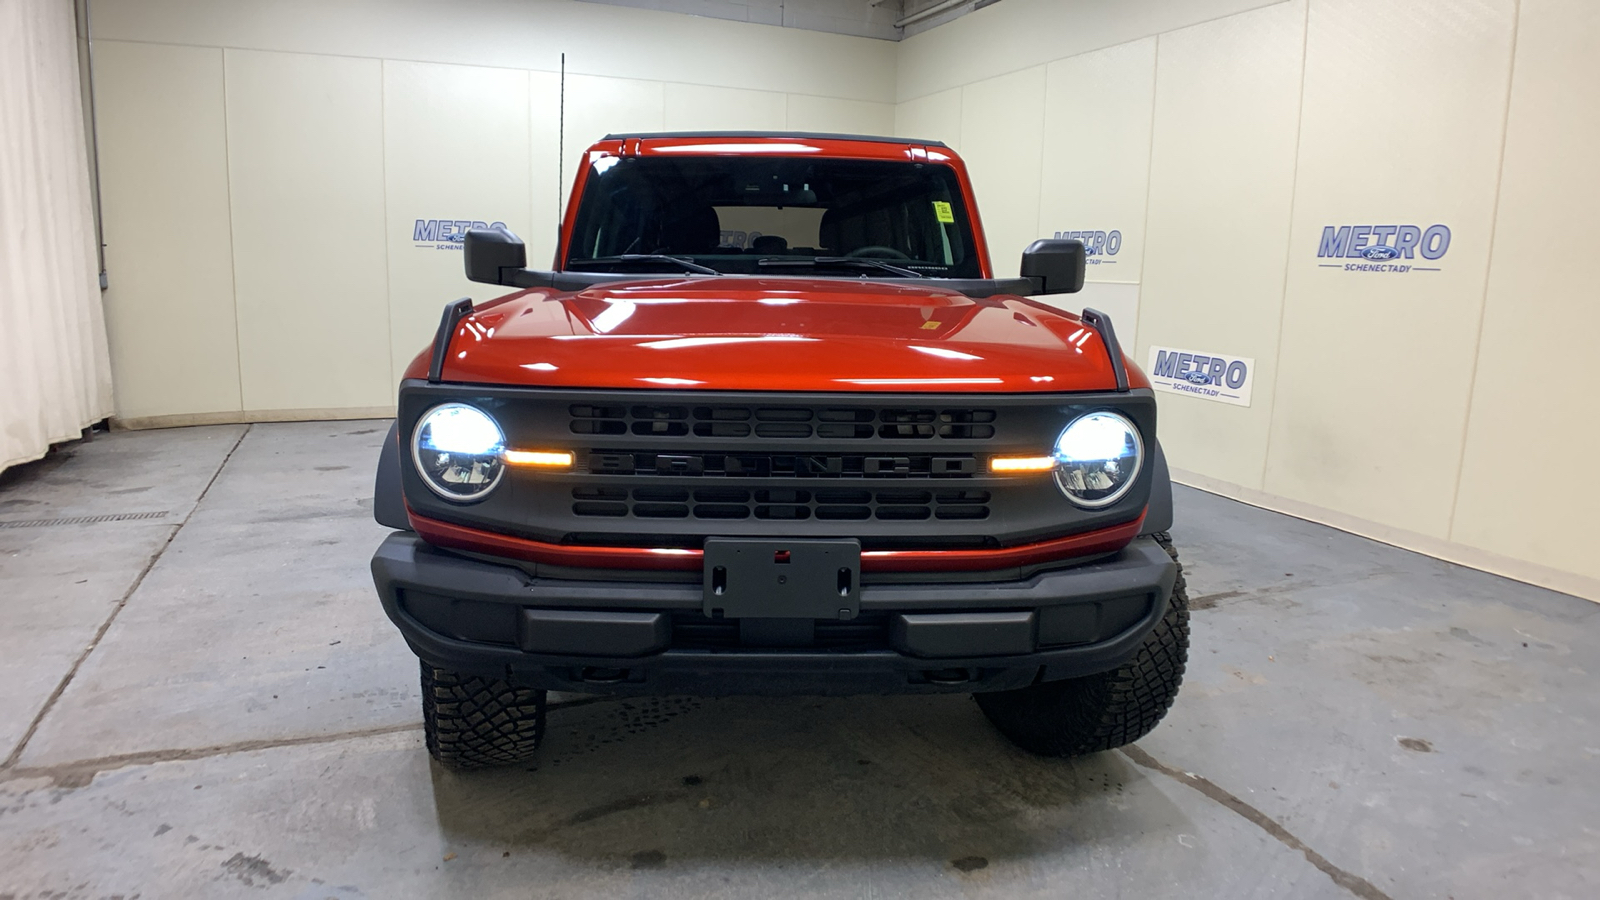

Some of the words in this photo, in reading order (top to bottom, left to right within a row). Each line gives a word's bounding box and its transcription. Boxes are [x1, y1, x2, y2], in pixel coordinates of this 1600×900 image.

[1317, 224, 1452, 260] METRO
[1367, 248, 1390, 259] Ford
[1344, 263, 1412, 273] SCHENECTADY
[1153, 350, 1247, 389] METRO
[1188, 373, 1206, 383] Ford
[1173, 383, 1220, 397] SCHENECTADY
[589, 454, 976, 476] BRONCO
